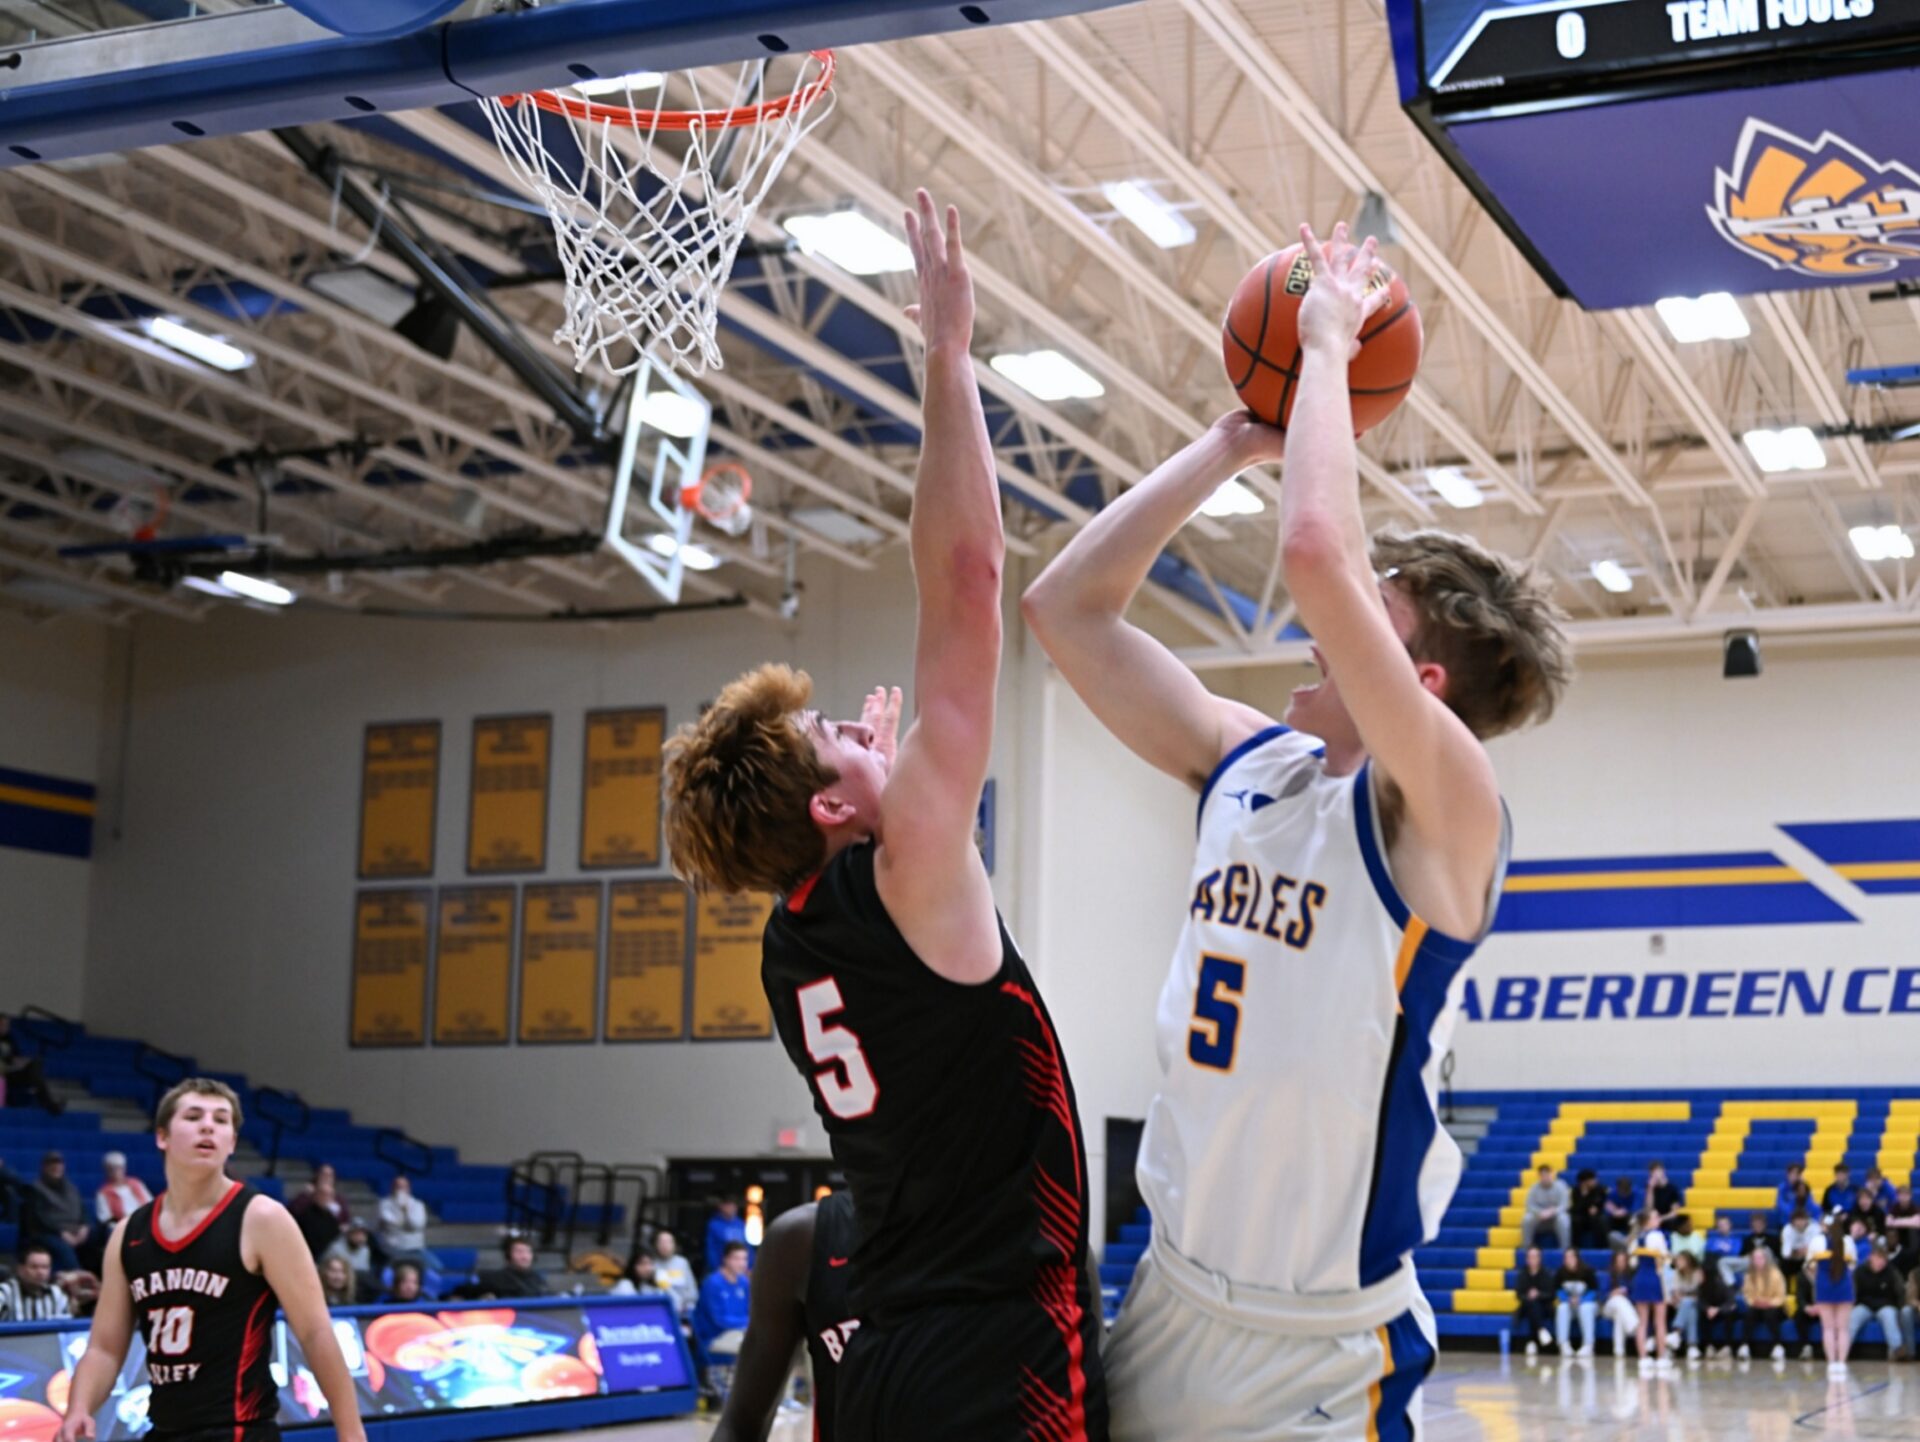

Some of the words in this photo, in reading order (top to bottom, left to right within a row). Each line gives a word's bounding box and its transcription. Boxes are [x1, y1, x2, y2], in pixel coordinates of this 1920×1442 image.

[1556, 11, 1586, 59] 0
[1666, 0, 1760, 42] TEAM
[1185, 950, 1247, 1076] 5
[1458, 968, 1835, 1022] ABERDEEN
[796, 975, 880, 1120] 5
[130, 1267, 230, 1303] RANDON
[147, 1306, 195, 1355] 10
